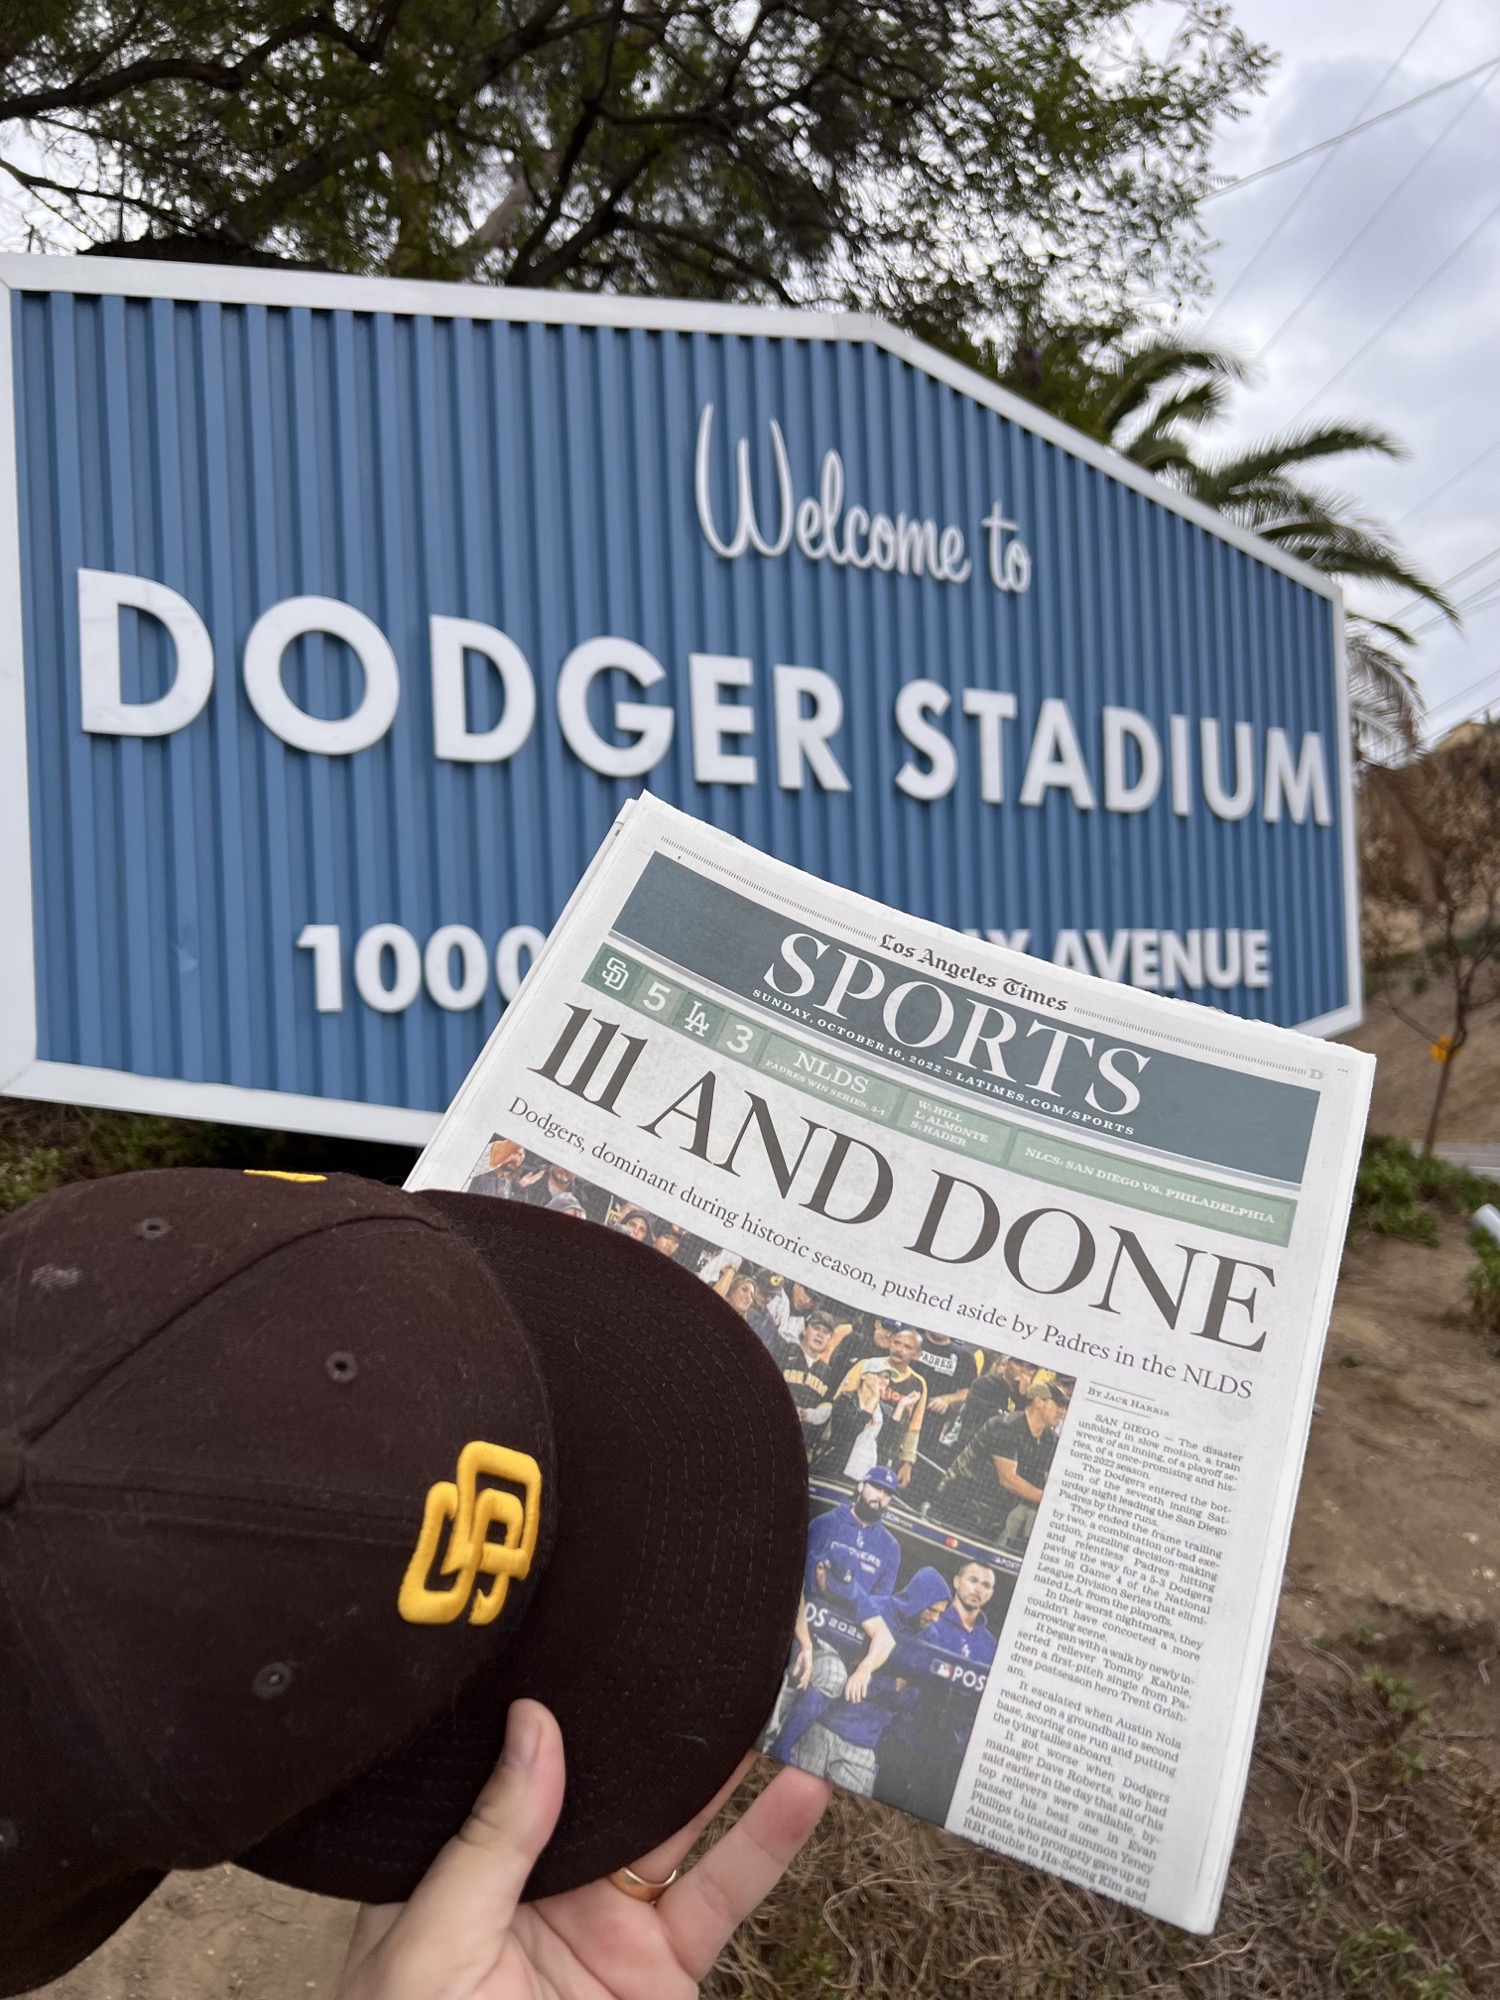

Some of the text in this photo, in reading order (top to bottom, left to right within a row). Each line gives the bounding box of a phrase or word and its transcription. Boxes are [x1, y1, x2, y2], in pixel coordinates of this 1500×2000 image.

[696, 402, 1031, 592] Welcome to
[78, 567, 1332, 826] DODGER STADIUM
[879, 933, 916, 958] Los
[917, 947, 998, 988] Angeles
[1002, 977, 1069, 1011] Times
[1052, 928, 1270, 989] AVENUE
[643, 981, 671, 1012] 5
[726, 1024, 754, 1054] 3
[763, 932, 1151, 1116] SPORTS
[752, 988, 1135, 1136] SUNDAY, OCTOBER 16, 2022 LATIMES.COM/SPORTS
[765, 1060, 886, 1117] PADRES WIN SERIES, 3-1
[793, 1050, 870, 1094] NLDS
[922, 1125, 966, 1147] HADER
[925, 1114, 989, 1143] ALMONTE
[932, 1105, 962, 1123] HILL
[526, 1002, 1276, 1353] 111 AND DONE
[1025, 1146, 1275, 1224] NLCS: SAN DIEGO VS. PHILADELPHIA
[507, 1096, 1253, 1400] Dodgers, dominant during historic season, pushed aside by Padres in the NLDS
[1077, 1420, 1121, 1437] unfolded
[1137, 1437, 1159, 1448] slow
[1215, 1457, 1240, 1471] train
[1094, 1413, 1243, 1461] SAN DIEGO The disaster
[1058, 1488, 1092, 1505] Padres
[1106, 1503, 1132, 1518] three
[1060, 1480, 1227, 1535] urday night leading the San Diego
[1063, 1468, 1084, 1481] tom
[1103, 1480, 1120, 1491] the
[1125, 1488, 1165, 1505] seventh
[1169, 1499, 1202, 1518] inning
[1080, 1462, 1100, 1475] The
[1103, 1469, 1145, 1488] Dodgers
[1148, 1483, 1187, 1500] entered
[1189, 1494, 1207, 1506] the
[1069, 1503, 1222, 1559] They ended the frame trailing
[1085, 1532, 1129, 1553] puzzling
[1132, 1545, 1218, 1581] decision-making
[1036, 1562, 1074, 1581] League
[1075, 1574, 1117, 1595] Division
[1119, 1589, 1151, 1607] Series
[1153, 1600, 1176, 1615] that
[1045, 1531, 1215, 1593] and relentless Padres hitting
[1033, 1574, 1063, 1589] nated
[1085, 1590, 1110, 1605] from
[1111, 1598, 1128, 1611] the
[1026, 1595, 1068, 1615] couldn't
[1072, 1609, 1097, 1625] have
[1101, 1621, 1156, 1645] concocted
[1172, 1645, 1200, 1661] more
[1058, 1593, 1081, 1608] their
[1084, 1603, 1113, 1618] worst
[1179, 1633, 1203, 1651] they
[1016, 1630, 1050, 1648] serted
[1056, 1644, 1094, 1664] reliever
[1101, 1658, 1143, 1683] Tommy
[1030, 1687, 1081, 1712] escalated
[1083, 1707, 1113, 1724] when
[1115, 1717, 1152, 1739] Austin
[1155, 1732, 1182, 1750] Nola
[1020, 1739, 1039, 1752] got
[1046, 1749, 1078, 1767] worse
[1085, 1764, 1115, 1782] when
[1122, 1776, 1170, 1803] Dodgers
[970, 1790, 1011, 1815] Phillips
[1026, 1812, 1067, 1838] instead
[1068, 1832, 1118, 1859] summon
[1120, 1851, 1154, 1876] Yency
[972, 1778, 1012, 1800] passed
[1019, 1795, 1037, 1811] his
[1045, 1805, 1070, 1824] best
[1077, 1820, 1099, 1836] one
[1127, 1839, 1157, 1859] Evan
